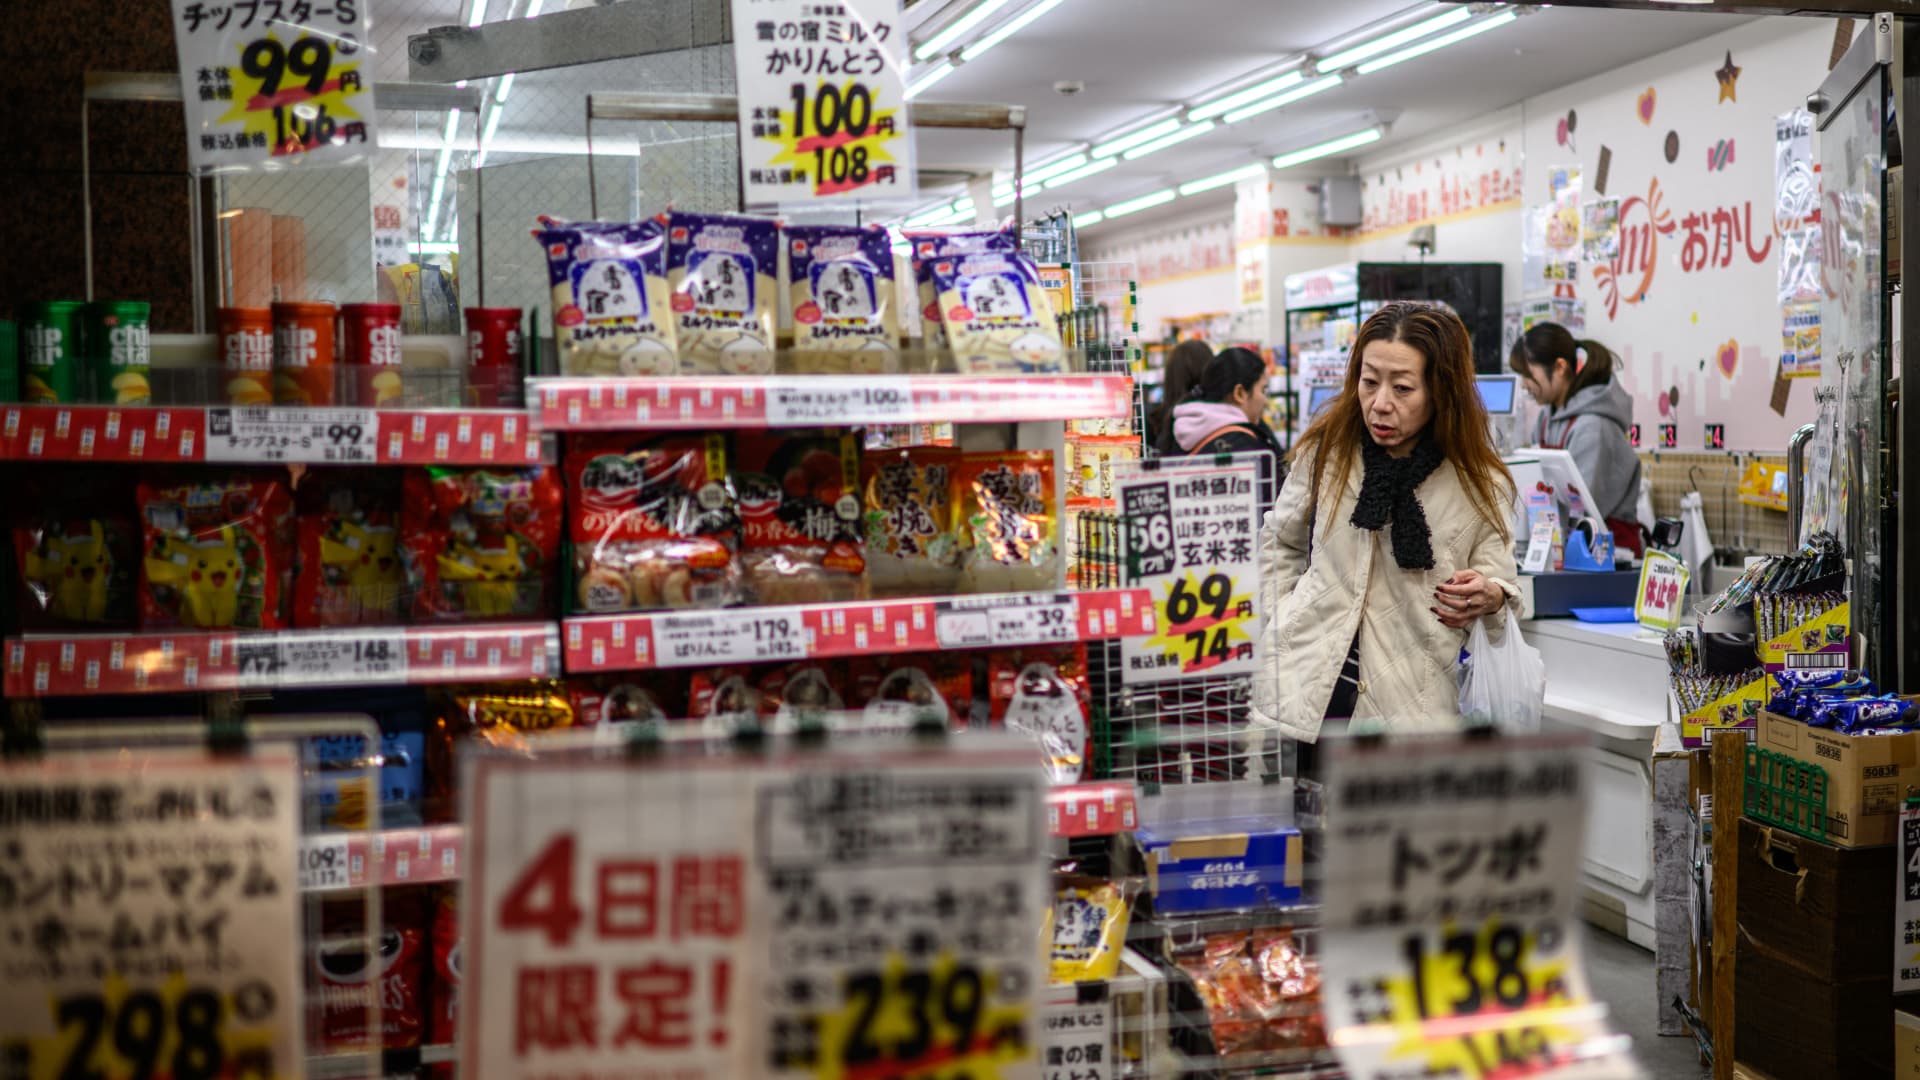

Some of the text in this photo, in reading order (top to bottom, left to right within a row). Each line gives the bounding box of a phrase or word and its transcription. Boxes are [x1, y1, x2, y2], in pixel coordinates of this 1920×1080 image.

[183, 0, 357, 33] チップスターS
[756, 20, 891, 44] 雪の宿ミルク
[242, 37, 331, 97] 99
[766, 47, 885, 75] かりんとう
[790, 83, 872, 138] 100
[815, 146, 869, 185] 108
[1681, 200, 1772, 273] おかし
[328, 424, 363, 445] 99
[1667, 425, 1676, 447] 3
[1713, 426, 1724, 448] 4
[1177, 517, 1250, 539] 山形つや姫
[1180, 538, 1251, 567] 玄米茶
[1166, 573, 1231, 625] 69
[1644, 575, 1679, 612] 休止中
[753, 618, 790, 641] 179
[1037, 608, 1065, 627] 39
[353, 639, 389, 662] 148
[1185, 627, 1230, 666] 74
[498, 830, 747, 948] 4日間
[1403, 923, 1530, 1020] 138
[515, 959, 732, 1052] 限定!
[844, 965, 985, 1064] 239
[55, 984, 226, 1080] 298
